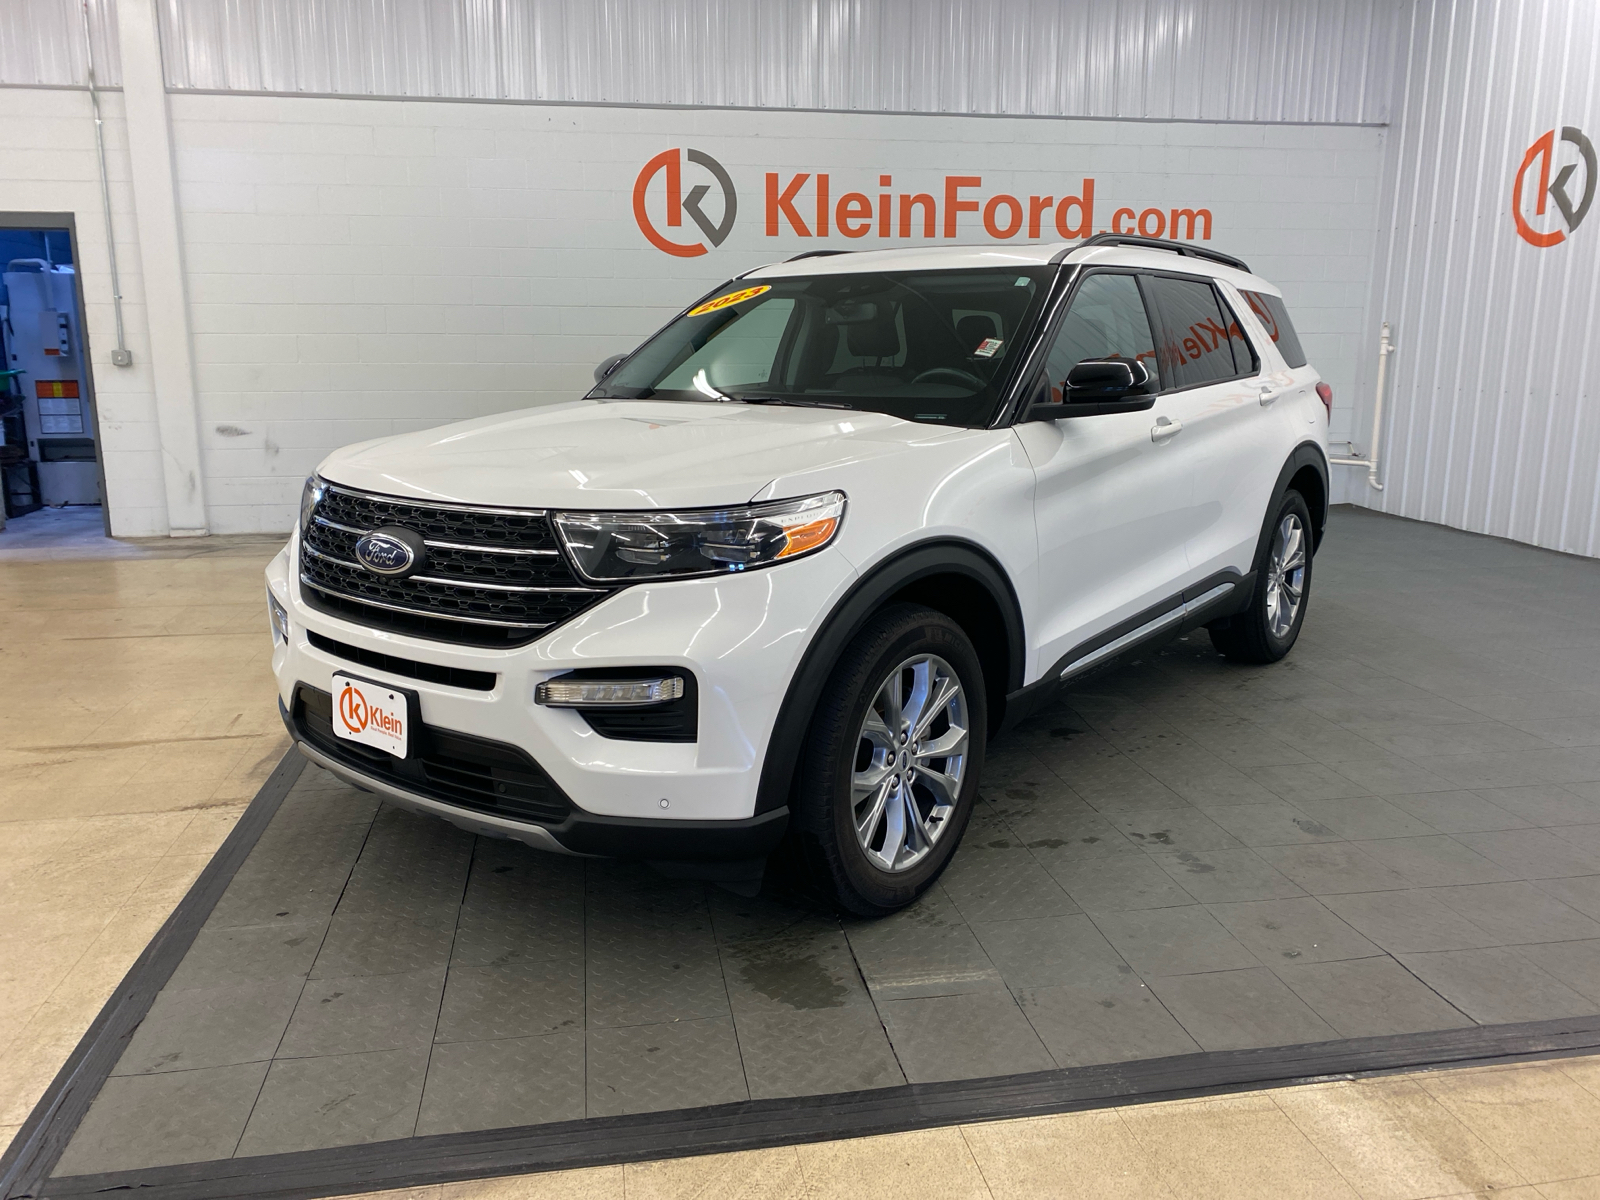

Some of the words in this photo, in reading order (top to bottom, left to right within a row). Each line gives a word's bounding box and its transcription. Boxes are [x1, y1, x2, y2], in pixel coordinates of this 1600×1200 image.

[765, 172, 1213, 240] KleinFord.com
[693, 286, 764, 315] 2023
[366, 540, 406, 565] Ford
[369, 705, 402, 735] Klein
